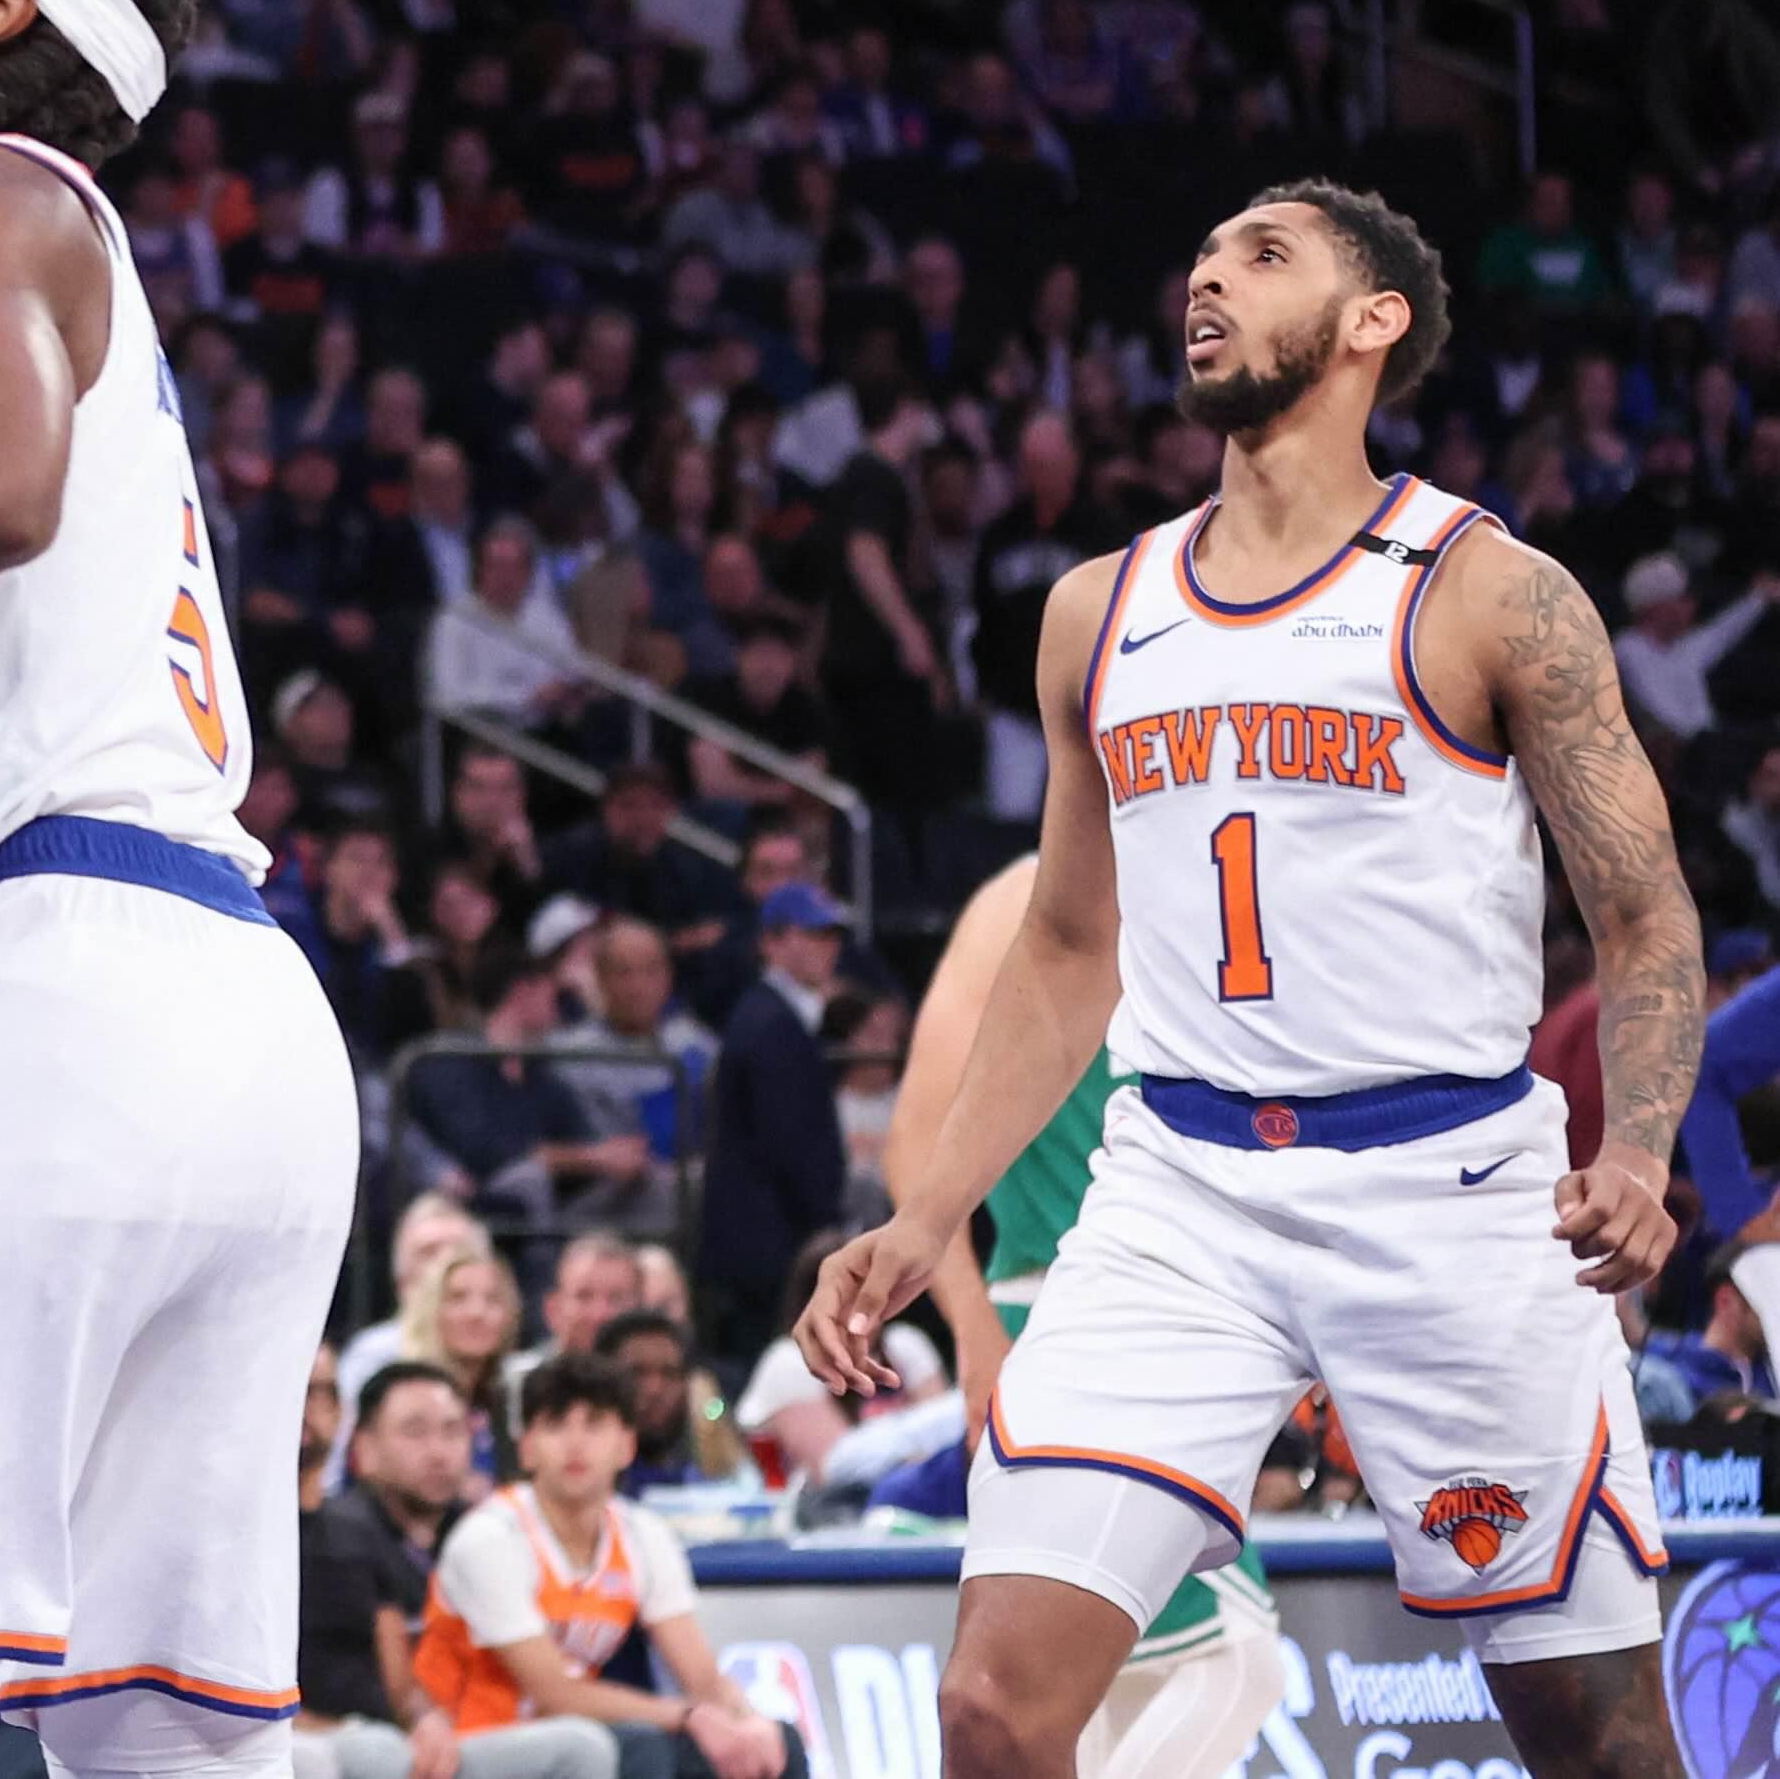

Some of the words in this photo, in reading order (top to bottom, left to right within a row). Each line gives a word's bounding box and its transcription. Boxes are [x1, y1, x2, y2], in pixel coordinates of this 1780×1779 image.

[1384, 541, 1409, 565] 12
[1291, 623, 1327, 638] abu
[1330, 622, 1385, 638] dhabi
[1098, 705, 1222, 808] NEW
[1227, 702, 1408, 797] YORK
[1210, 810, 1274, 1004] 1
[1419, 1483, 1529, 1533] KNICKS
[1325, 1649, 1502, 1726] Presented
